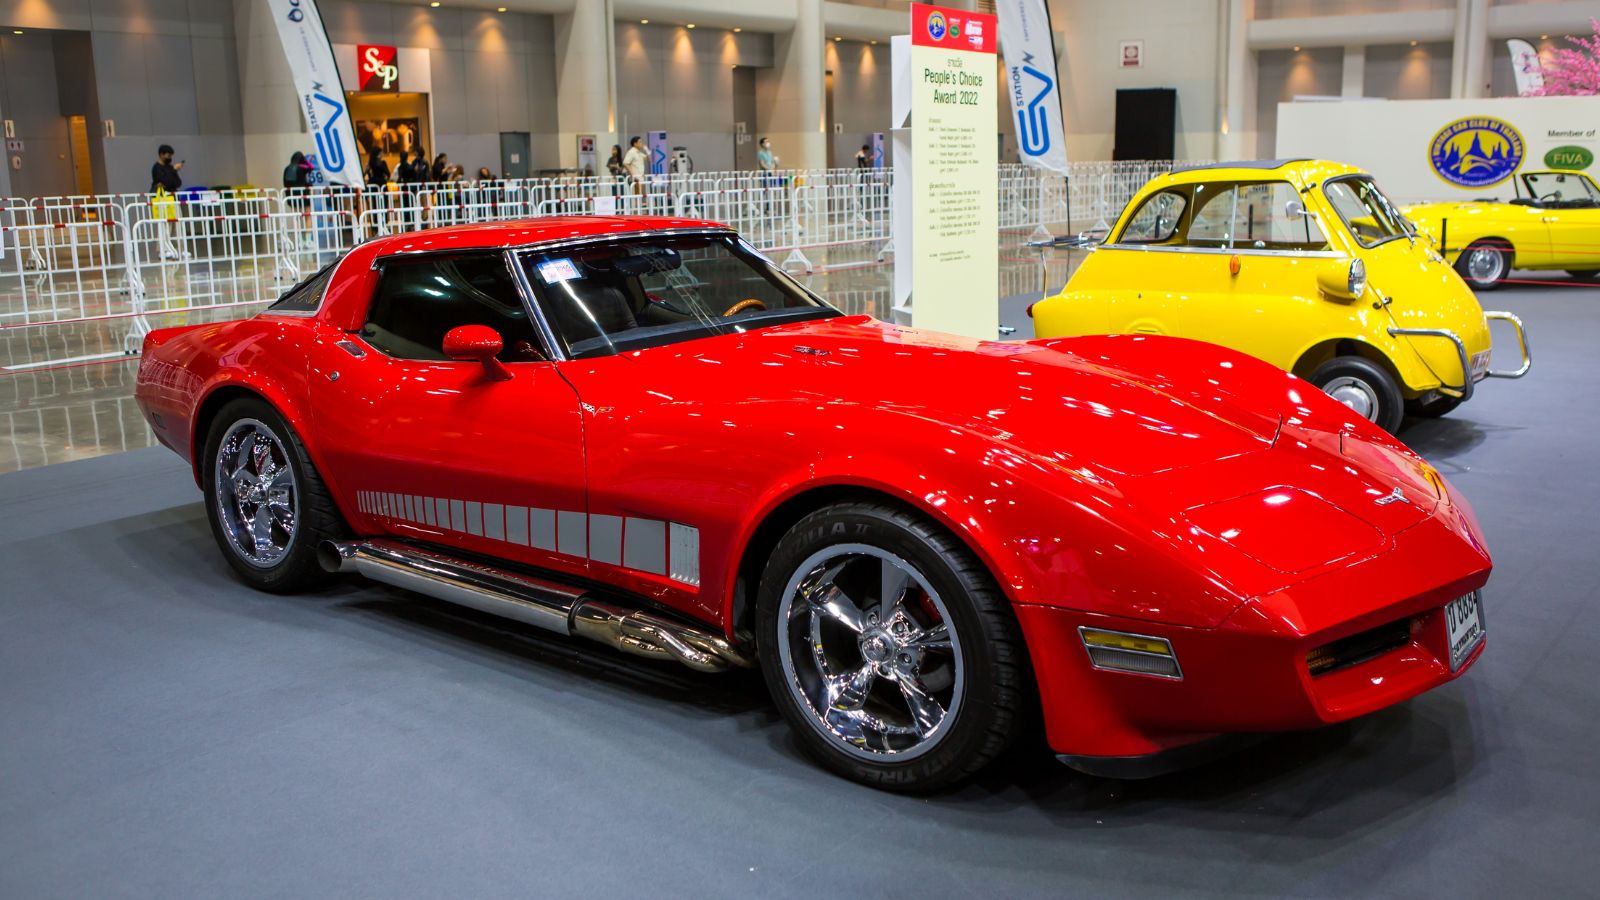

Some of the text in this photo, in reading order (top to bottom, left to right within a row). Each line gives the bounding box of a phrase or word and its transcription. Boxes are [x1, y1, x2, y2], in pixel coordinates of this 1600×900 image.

[924, 68, 983, 87] People's Choice
[1012, 66, 1024, 107] STATION
[934, 89, 978, 105] Award 2022
[304, 94, 320, 131] STATION
[1547, 129, 1597, 137] Member of
[1552, 152, 1585, 165] FIVA
